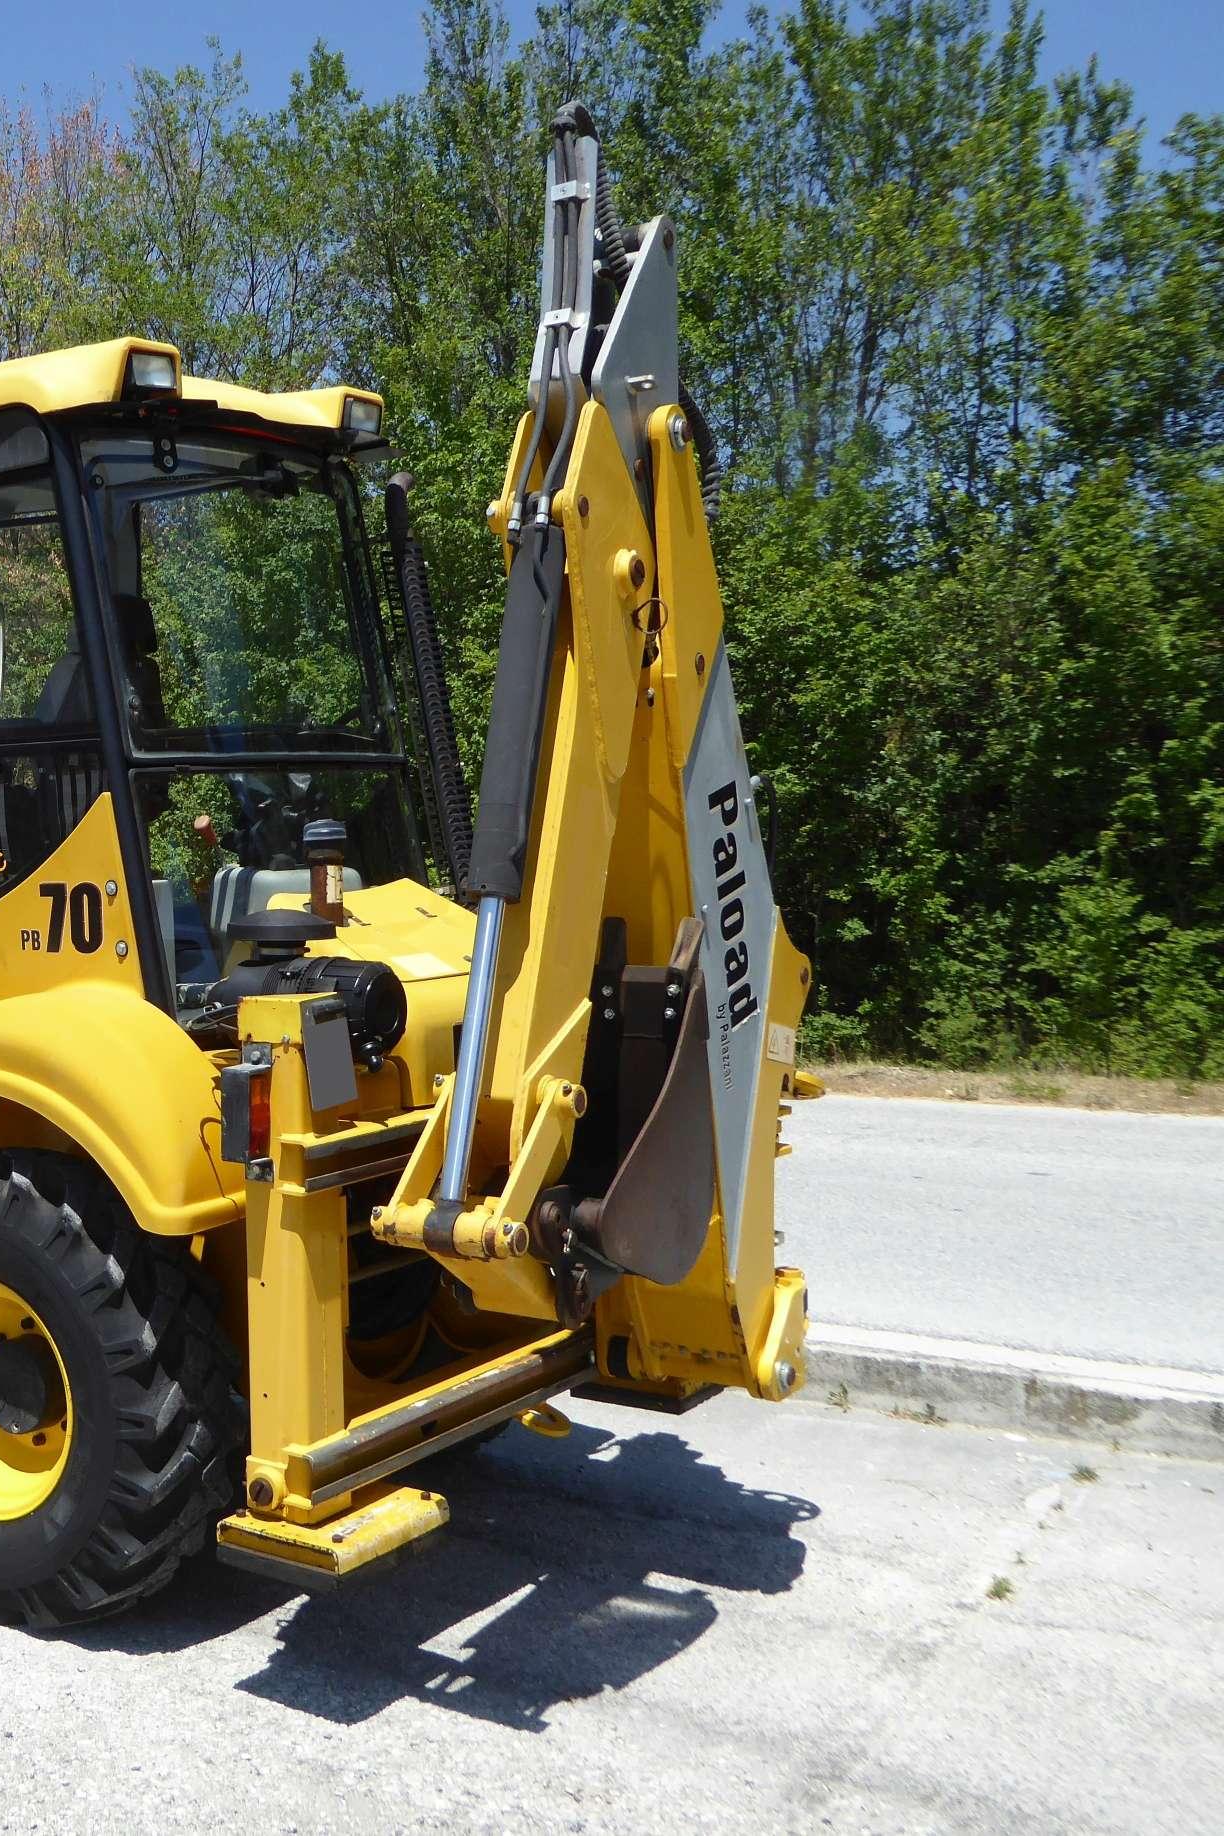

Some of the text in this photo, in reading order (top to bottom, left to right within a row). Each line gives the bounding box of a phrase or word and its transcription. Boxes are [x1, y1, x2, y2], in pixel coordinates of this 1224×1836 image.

[21, 882, 105, 954] PB 70
[707, 780, 759, 1031] Paload
[716, 1002, 727, 1020] by
